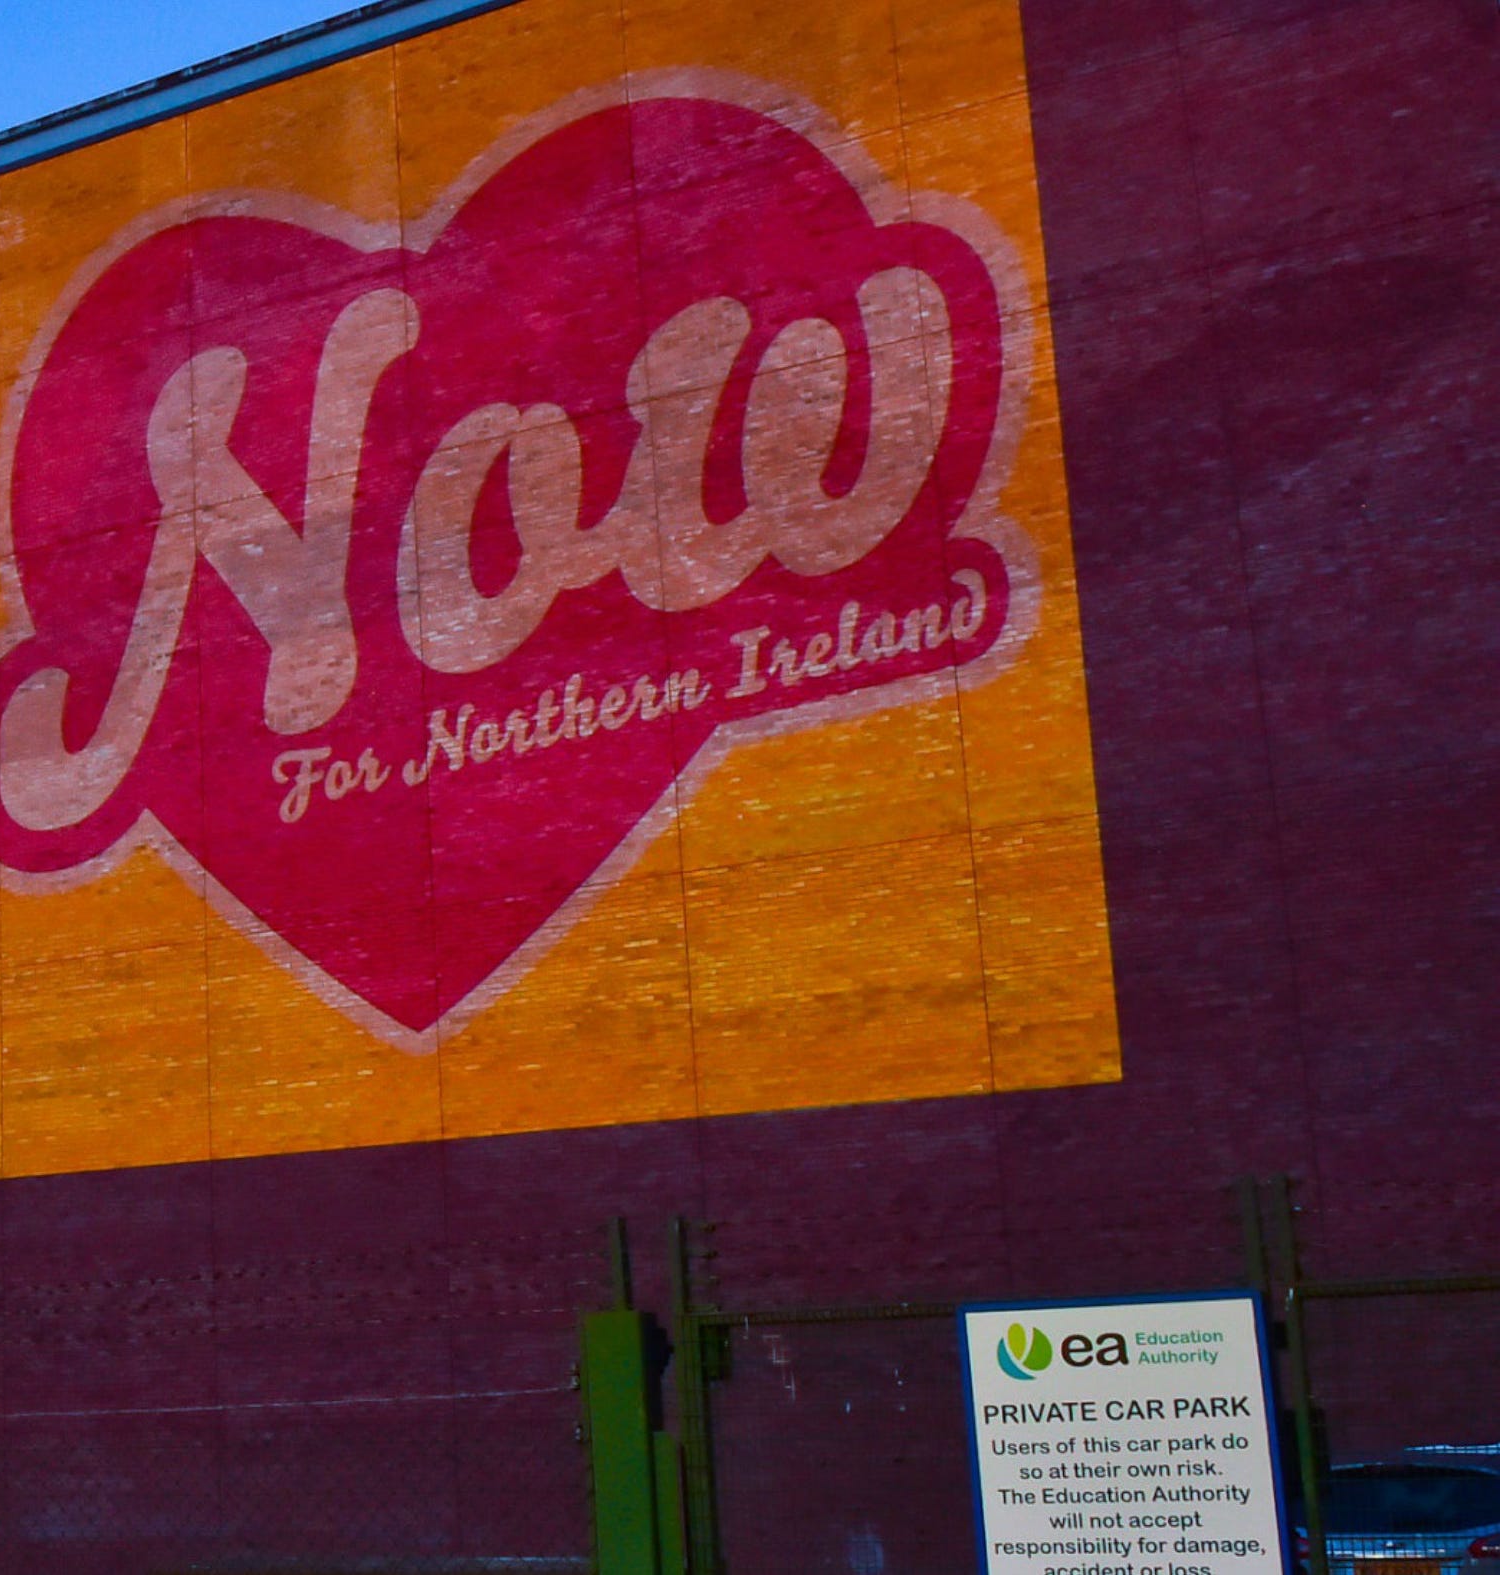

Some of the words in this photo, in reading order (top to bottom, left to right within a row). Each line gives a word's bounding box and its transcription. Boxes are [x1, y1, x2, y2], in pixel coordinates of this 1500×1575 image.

[272, 747, 390, 824] For
[403, 671, 711, 786] Northern
[724, 567, 987, 700] Ireland
[1135, 1330, 1223, 1346] Education
[1061, 1333, 1128, 1367] ea
[1138, 1349, 1218, 1365] Authority
[984, 1402, 1097, 1424] PRIVATE
[1105, 1400, 1164, 1421] CAR
[1174, 1396, 1251, 1418] PARK
[992, 1438, 1050, 1455] Users
[1056, 1438, 1076, 1454] of
[1084, 1436, 1120, 1452] this
[1127, 1438, 1159, 1452] car
[1168, 1434, 1215, 1454] park
[1222, 1433, 1248, 1450] do
[1020, 1468, 1042, 1480] so
[1049, 1464, 1068, 1479] at
[1074, 1462, 1121, 1478] their
[1128, 1464, 1170, 1477] own
[1177, 1459, 1223, 1476] risk.
[998, 1488, 1036, 1505] The
[1042, 1487, 1145, 1504] Education
[1152, 1485, 1250, 1504] Authority
[1050, 1513, 1083, 1529] will
[1090, 1513, 1122, 1529] not
[1129, 1511, 1203, 1531] accept
[994, 1537, 1132, 1558] responsibility
[1139, 1536, 1168, 1554] for
[1174, 1535, 1266, 1556] damage,
